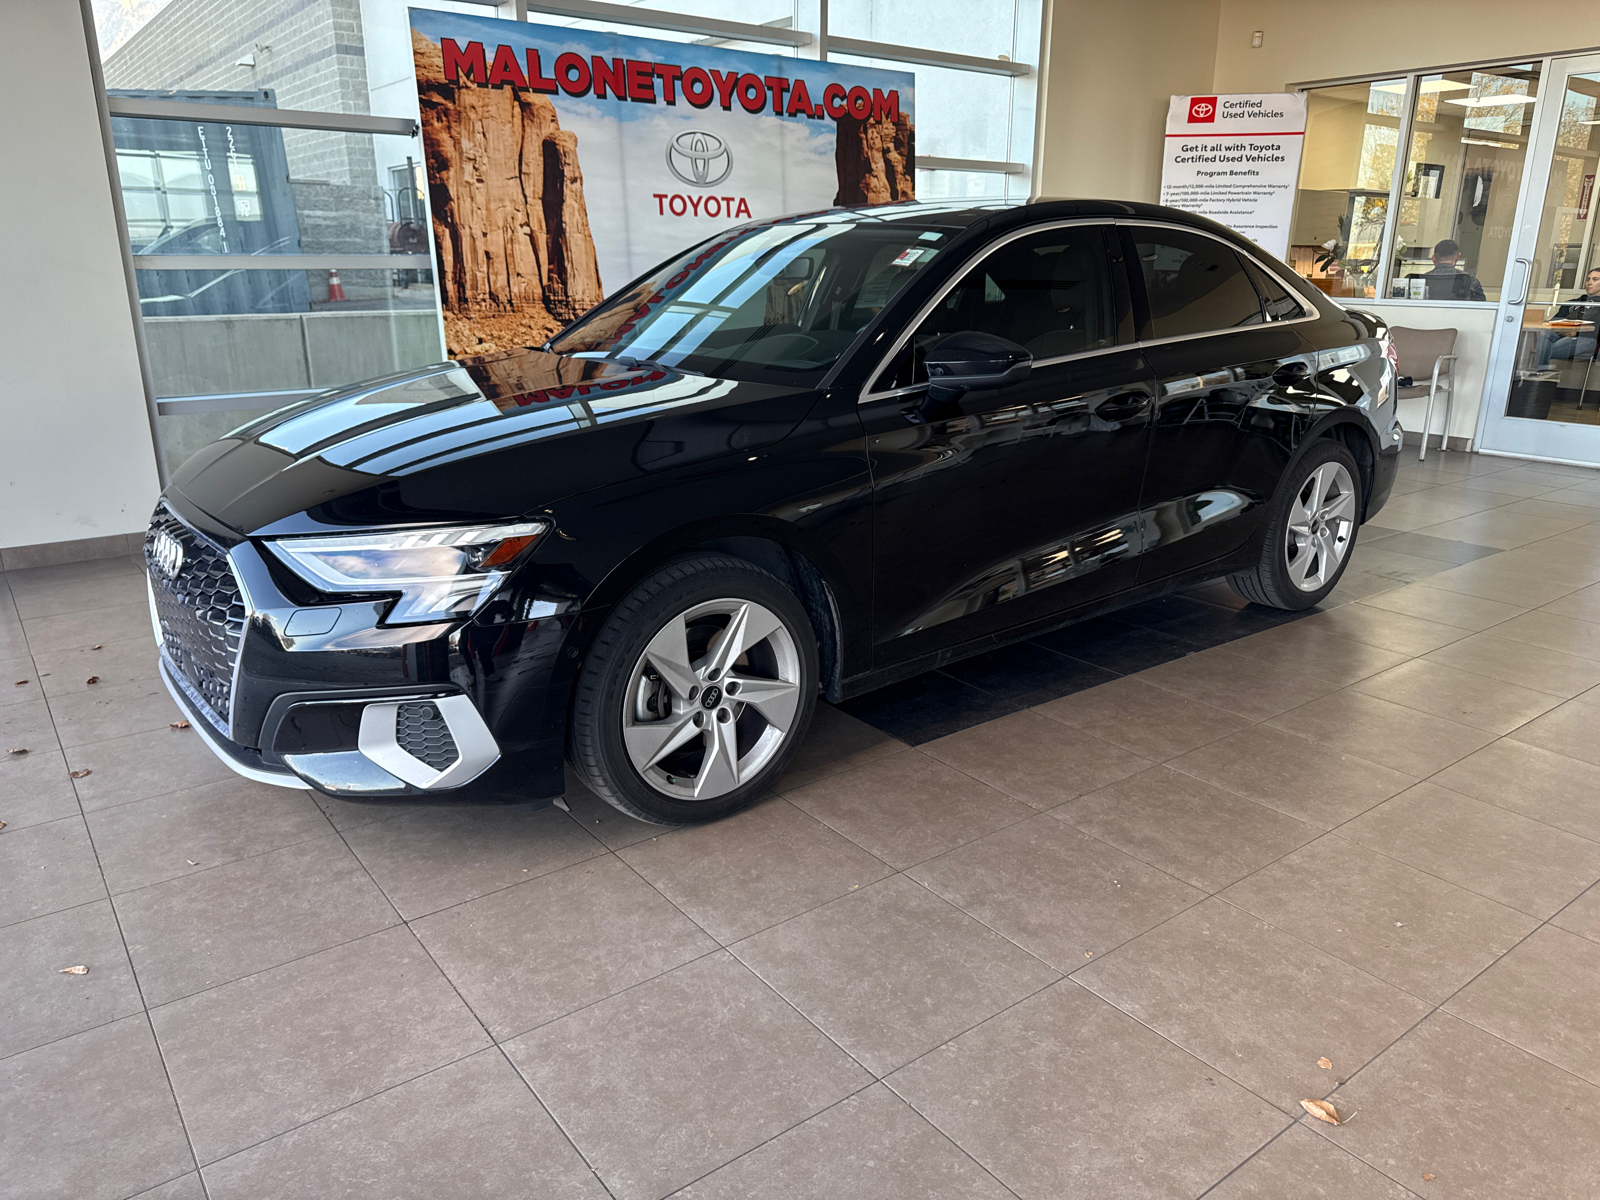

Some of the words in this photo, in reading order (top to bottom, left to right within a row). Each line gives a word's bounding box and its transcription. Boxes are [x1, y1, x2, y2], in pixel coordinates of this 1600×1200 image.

[440, 37, 899, 124] MALONETOYOTA.COM
[1223, 100, 1262, 109] Certified
[1222, 110, 1244, 118] Used
[1246, 110, 1284, 118] Vehicles
[1181, 144, 1198, 152] Get
[1200, 144, 1208, 152] it
[1210, 144, 1222, 152] all
[1224, 143, 1246, 152] with
[1248, 143, 1281, 153] Toyota
[1174, 154, 1217, 163] Certified
[1218, 154, 1243, 162] Used
[1245, 154, 1285, 162] Vehicles
[653, 193, 752, 219] TOYOTA
